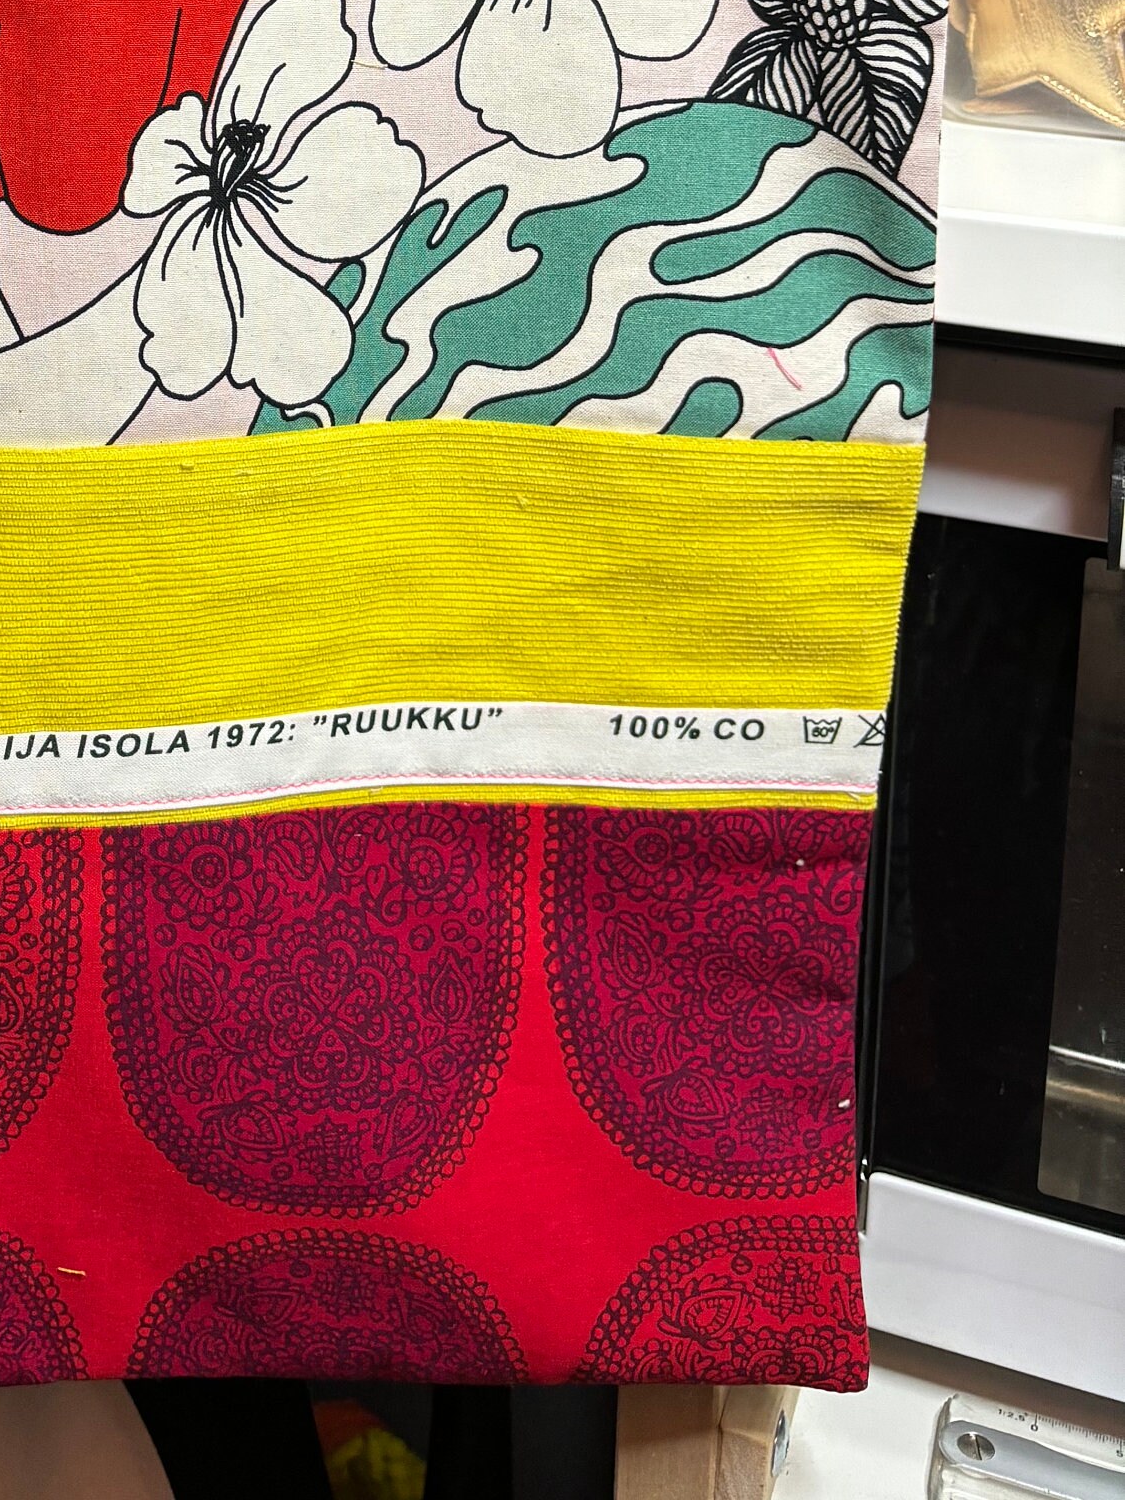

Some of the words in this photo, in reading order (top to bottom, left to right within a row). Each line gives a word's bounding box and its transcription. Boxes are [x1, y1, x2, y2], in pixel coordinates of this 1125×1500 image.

[77, 730, 190, 759] ISOLA
[207, 720, 296, 749] 1972:
[610, 714, 701, 740] 100%
[714, 718, 765, 741] CO
